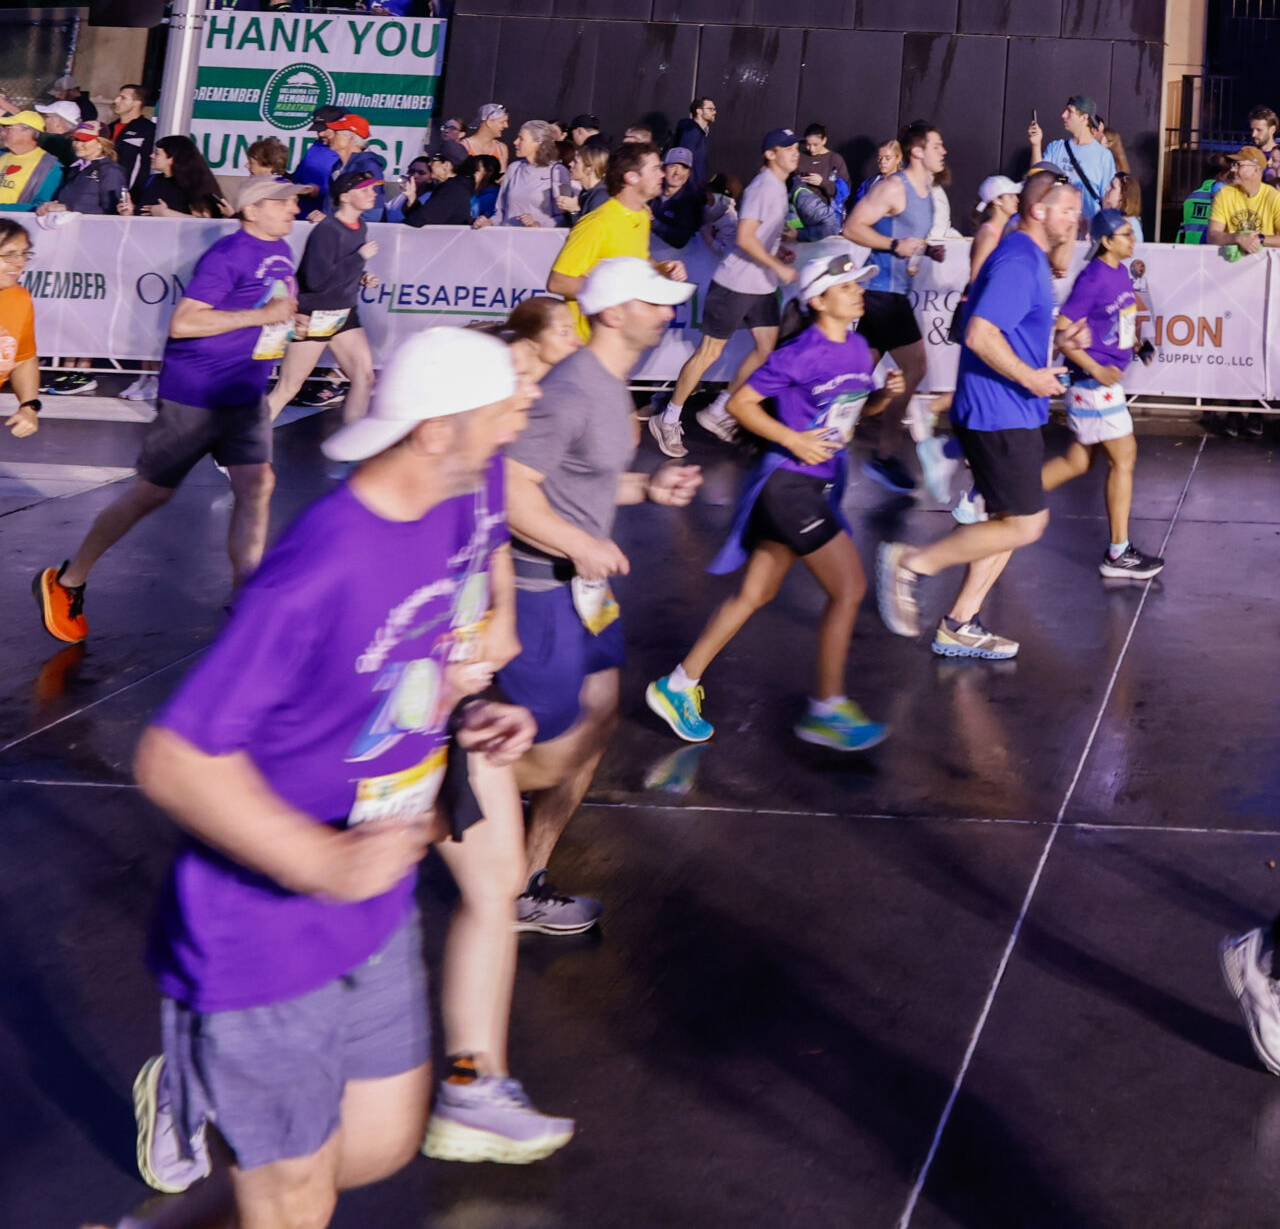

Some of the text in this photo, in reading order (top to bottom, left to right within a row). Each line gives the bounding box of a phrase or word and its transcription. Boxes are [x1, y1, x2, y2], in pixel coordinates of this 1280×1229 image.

[204, 16, 441, 58] HANK YOU
[24, 271, 106, 300] MEMBER
[361, 283, 546, 309] CHESAPEAK
[1158, 353, 1202, 365] SUPPLY
